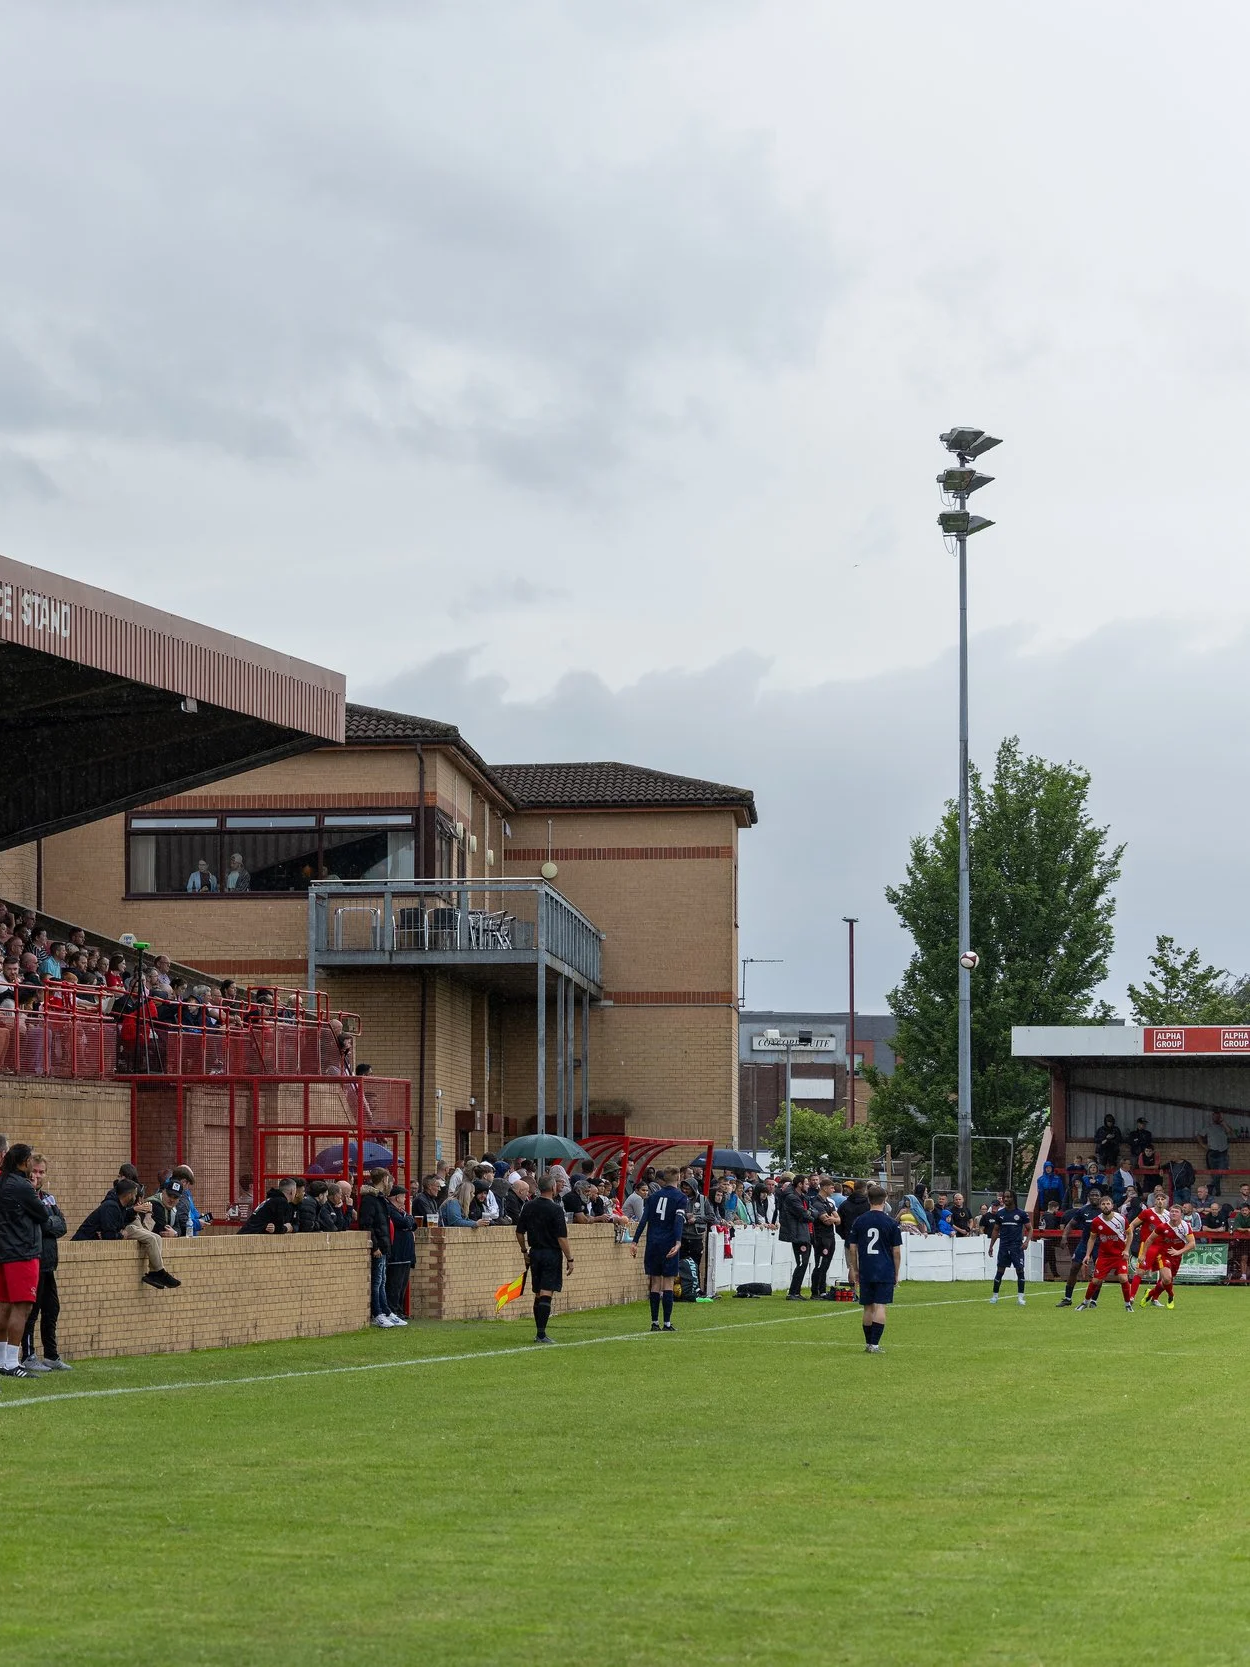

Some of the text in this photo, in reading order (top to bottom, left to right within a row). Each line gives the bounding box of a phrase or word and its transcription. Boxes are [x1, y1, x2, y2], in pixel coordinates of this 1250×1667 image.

[22, 592, 71, 638] STAND
[656, 1196, 668, 1221] 4
[866, 1227, 880, 1255] 2
